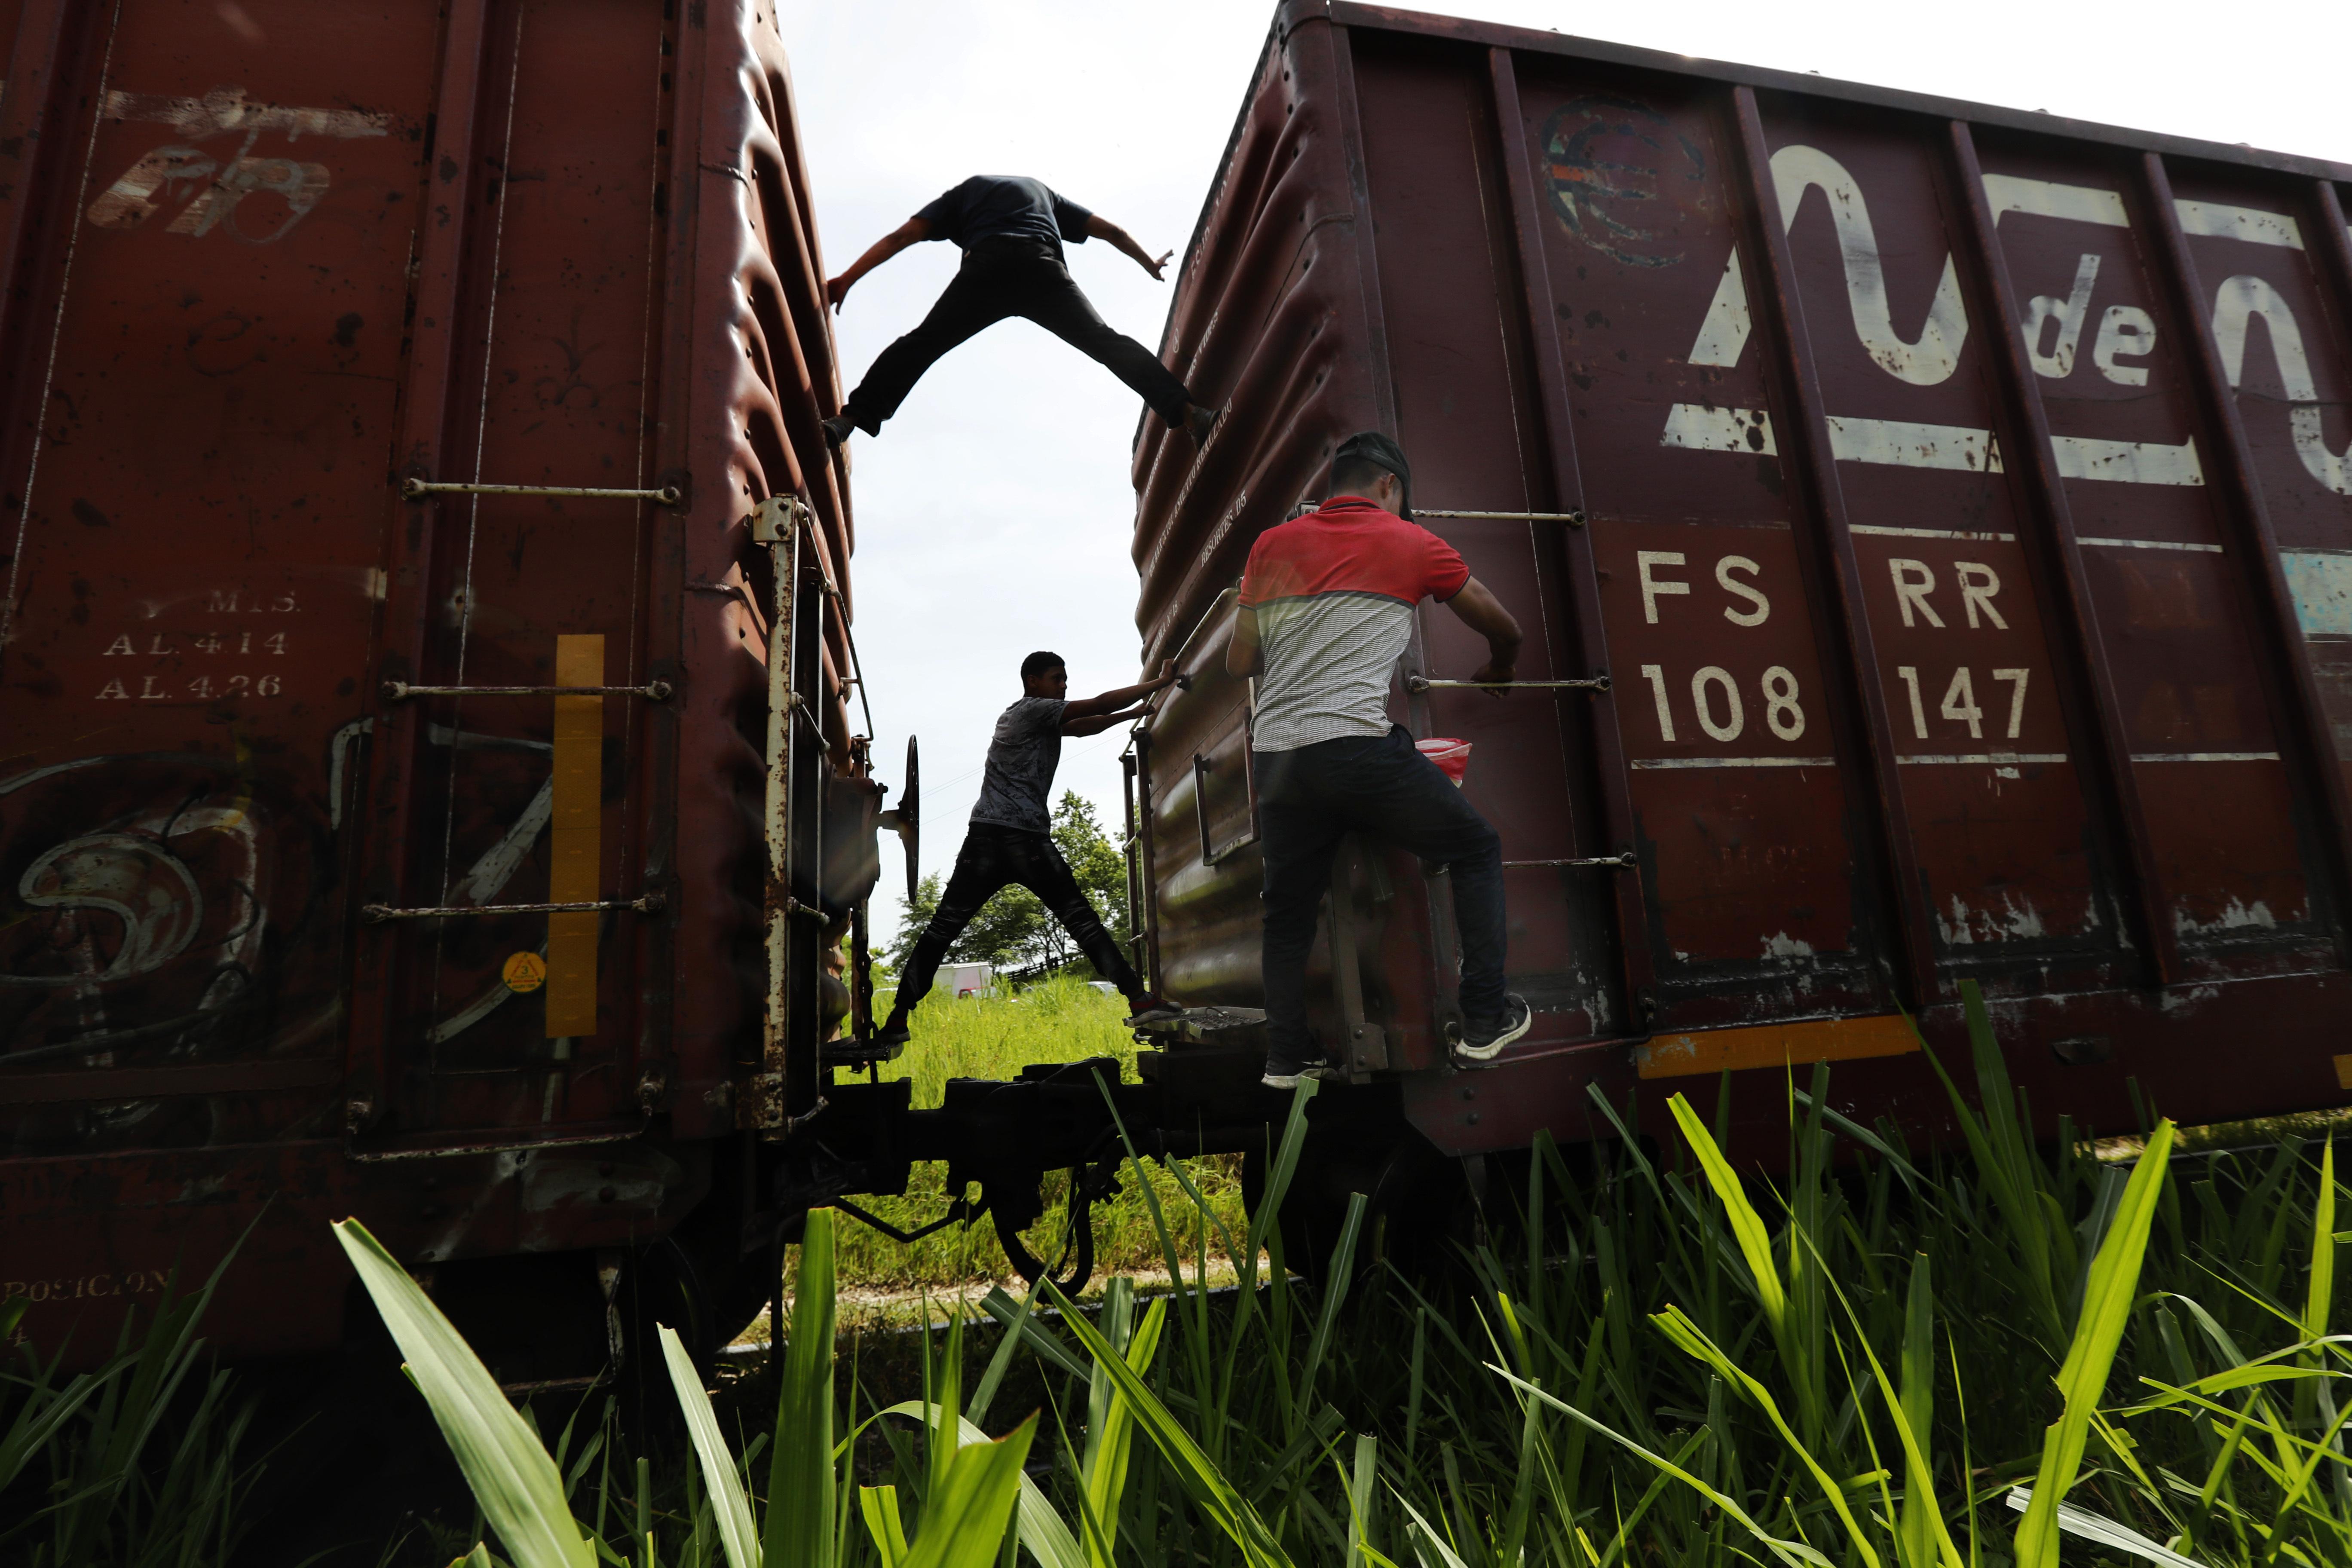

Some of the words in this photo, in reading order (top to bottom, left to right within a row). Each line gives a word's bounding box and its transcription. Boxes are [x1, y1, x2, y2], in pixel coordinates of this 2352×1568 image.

[2024, 253, 2156, 386] de
[1201, 509, 1233, 567] RESORTES
[1236, 490, 1246, 516] D5
[1641, 663, 1805, 742] 108
[1897, 665, 2030, 740] 147
